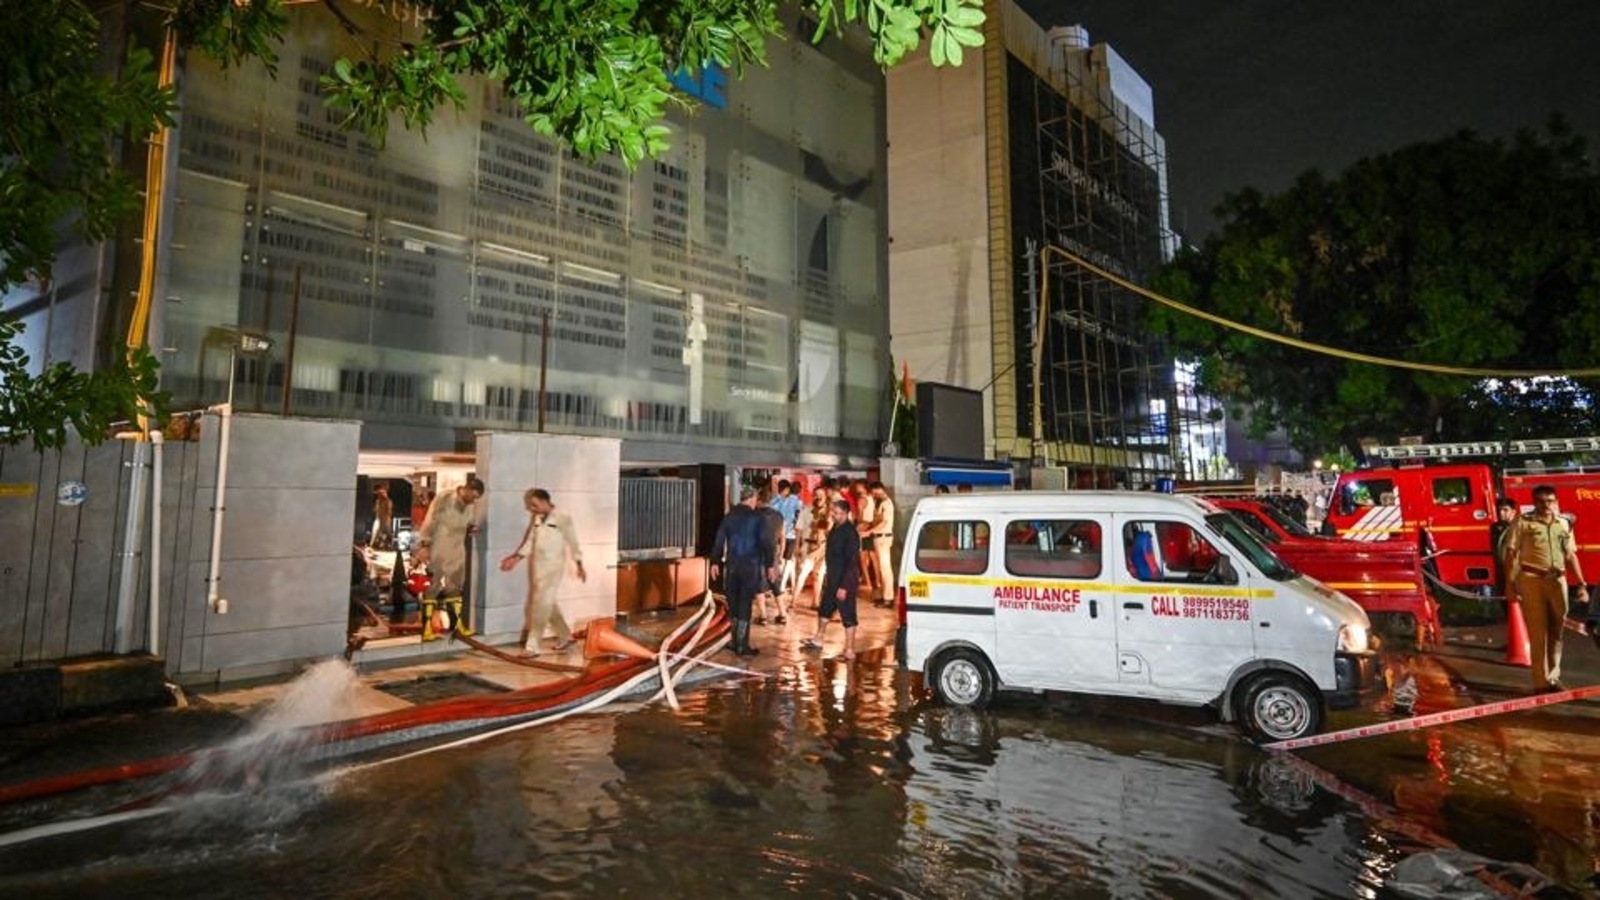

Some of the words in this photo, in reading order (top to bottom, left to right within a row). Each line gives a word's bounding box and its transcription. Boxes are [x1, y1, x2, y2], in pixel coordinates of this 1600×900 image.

[994, 586, 1081, 604] AMBULANCE
[999, 600, 1029, 611] PATIENT
[1031, 602, 1076, 613] TRANSPORT
[1151, 596, 1179, 616] CALL
[1183, 597, 1249, 609] 9899519540
